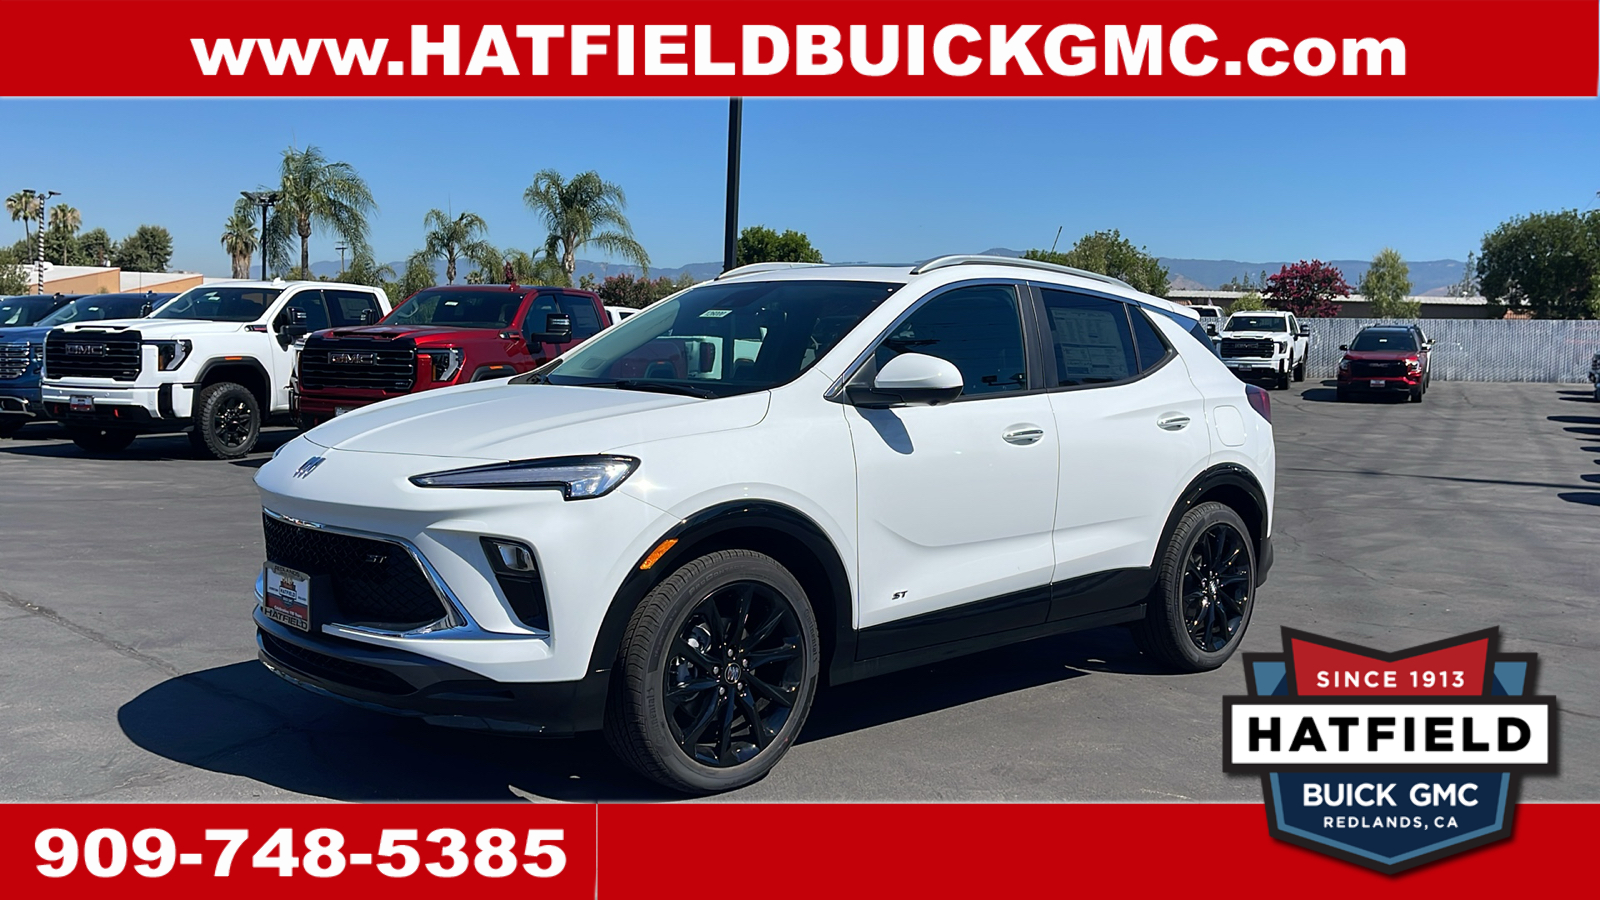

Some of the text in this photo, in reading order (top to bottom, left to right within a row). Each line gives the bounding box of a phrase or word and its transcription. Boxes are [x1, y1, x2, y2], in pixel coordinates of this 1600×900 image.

[66, 344, 103, 355] GMC
[331, 353, 374, 364] GMC
[891, 590, 908, 601] ST
[264, 607, 308, 630] HATFIELD
